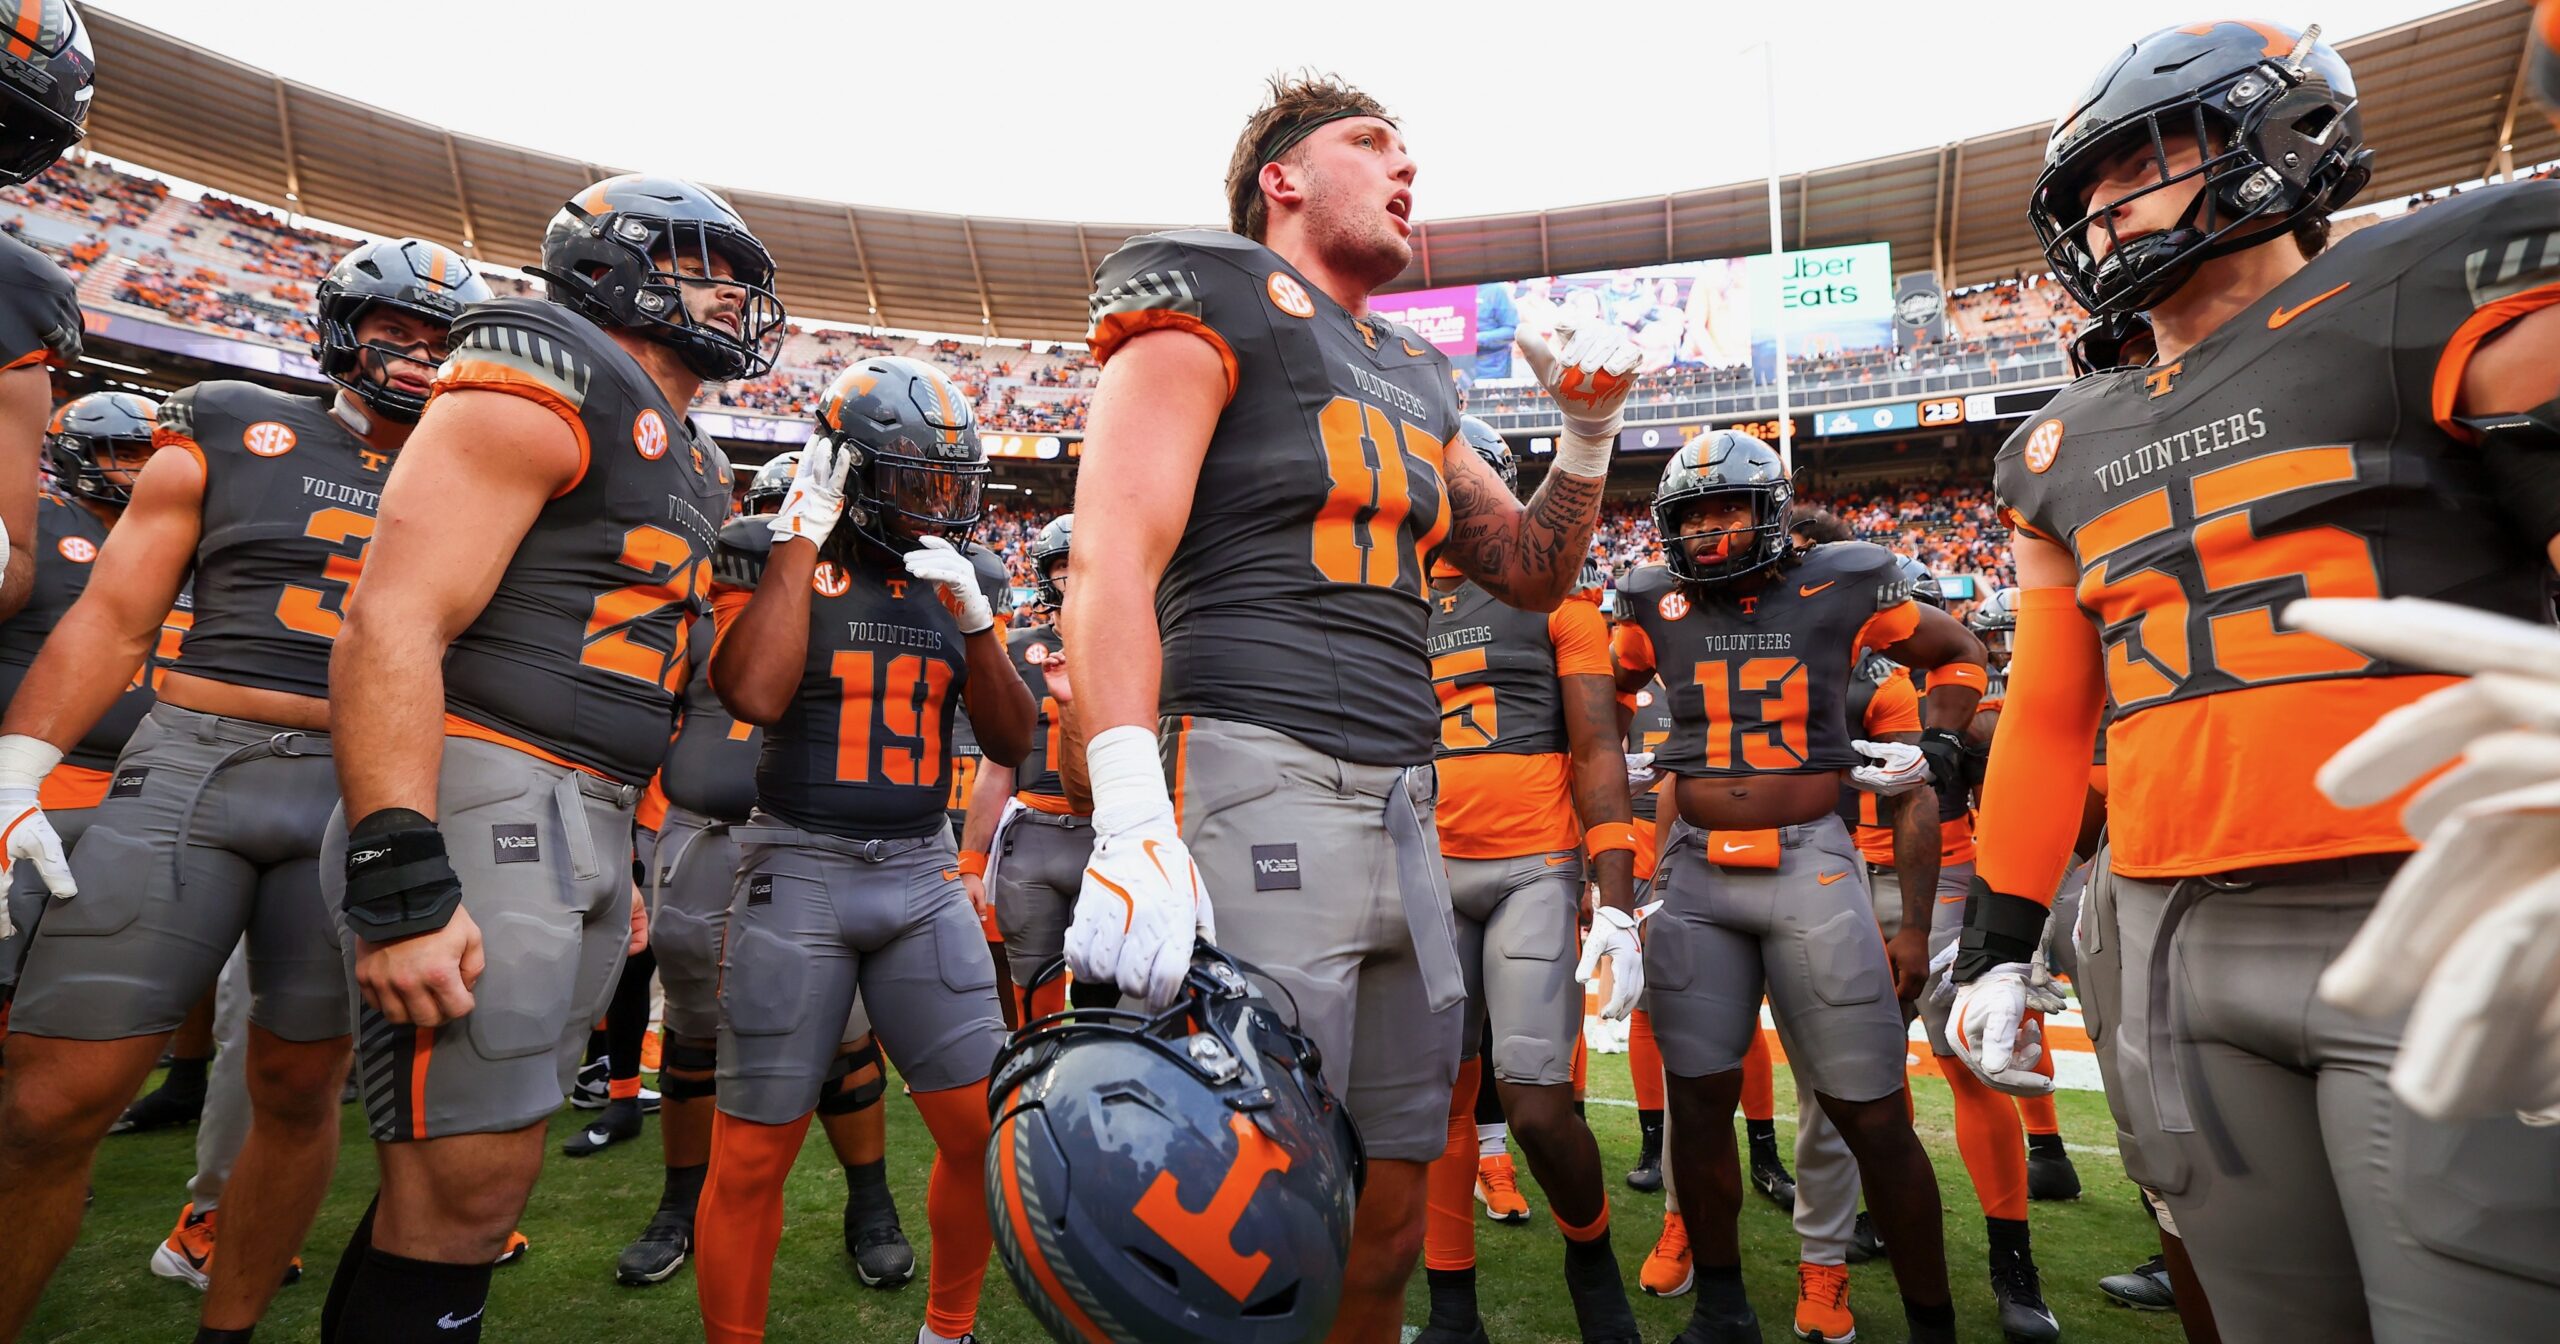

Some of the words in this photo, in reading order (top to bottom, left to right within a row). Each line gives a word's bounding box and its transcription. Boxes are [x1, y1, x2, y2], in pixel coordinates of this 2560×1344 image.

[1347, 363, 1427, 421] VOLUNTEERS
[2144, 361, 2184, 400] T
[1873, 409, 1893, 429] 0
[1924, 401, 1959, 423] 25
[248, 423, 292, 454] SEC
[1642, 429, 1660, 448] 0
[2027, 422, 2062, 468] SEC
[2094, 407, 2267, 493] VOLUNTEERS
[359, 449, 388, 473] T
[1311, 395, 1452, 602] 87
[62, 537, 94, 562] SEC
[274, 506, 379, 640] 3
[2075, 445, 2381, 708] 55
[886, 579, 908, 599] T
[1439, 595, 1457, 614] T
[1661, 592, 1688, 618] SEC
[1739, 597, 1758, 615] T
[847, 621, 942, 651] VOLUNTEERS
[1426, 625, 1492, 655] OLUNTEERS
[1705, 633, 1792, 653] VOLUNTEERS
[1430, 646, 1498, 750] 5
[1693, 656, 1809, 770] 13
[830, 649, 954, 788] 19
[1132, 1110, 1292, 1304] T
